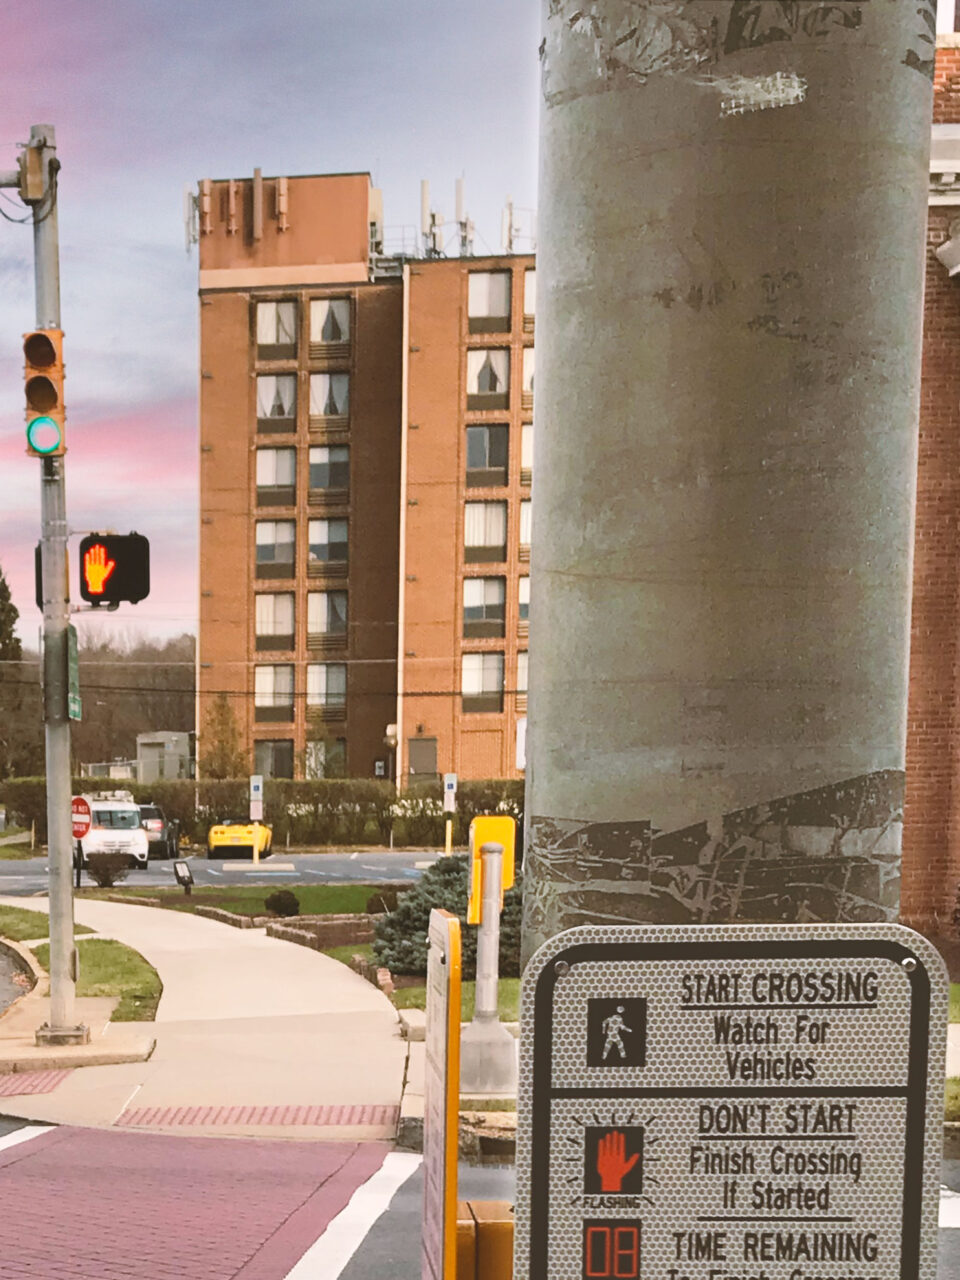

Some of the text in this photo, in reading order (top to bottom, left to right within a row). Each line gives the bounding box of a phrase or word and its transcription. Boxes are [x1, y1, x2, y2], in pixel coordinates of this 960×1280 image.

[681, 972, 878, 1003] START CROSSING
[713, 1014, 830, 1044] Watch For
[726, 1050, 816, 1080] Vehicles
[698, 1104, 857, 1133] DON'T START
[690, 1146, 862, 1183] Finish Crossing
[582, 1196, 642, 1209] FLASHING
[723, 1180, 830, 1210] If Started
[672, 1232, 879, 1262] TIME REMAINING
